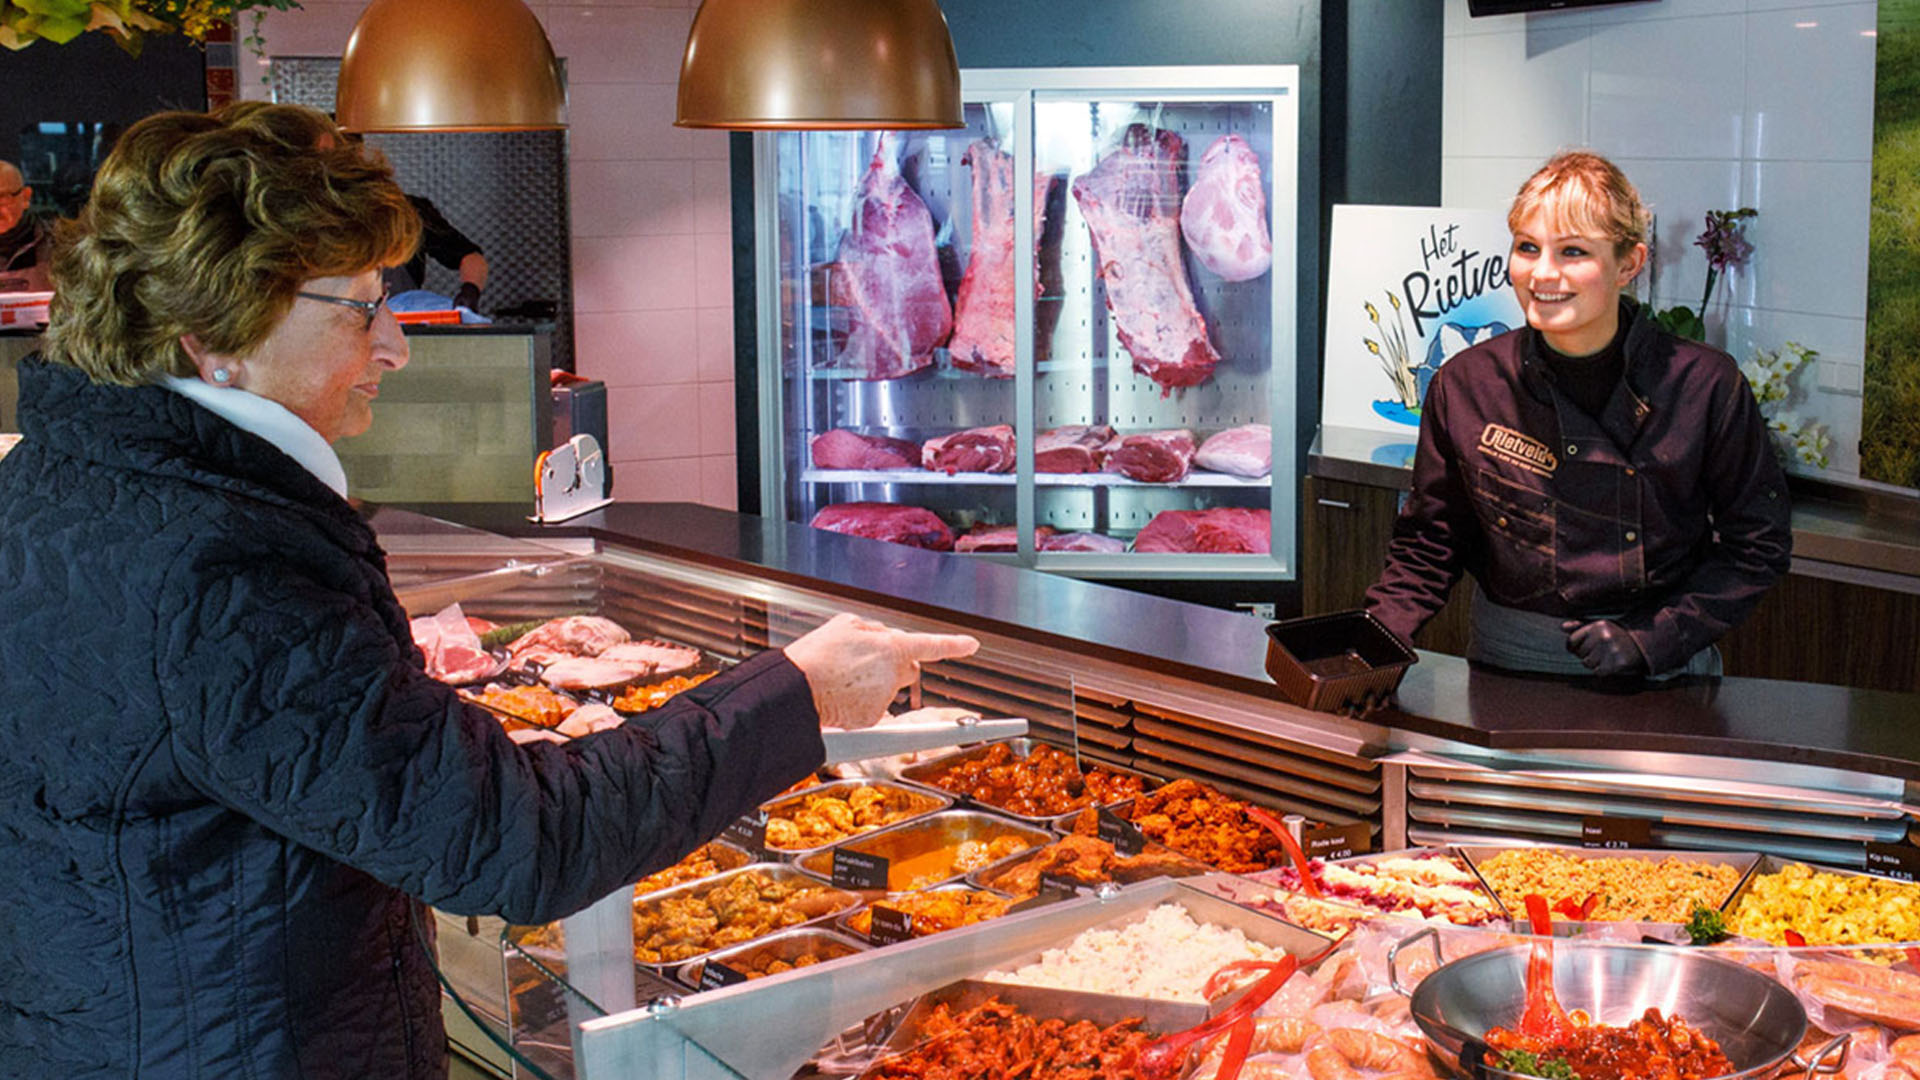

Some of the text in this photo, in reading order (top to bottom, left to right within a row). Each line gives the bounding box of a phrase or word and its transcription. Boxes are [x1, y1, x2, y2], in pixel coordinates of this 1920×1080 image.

[1421, 224, 1460, 271] Het
[1402, 249, 1513, 338] Rietve
[1491, 428, 1551, 464] Rietveld
